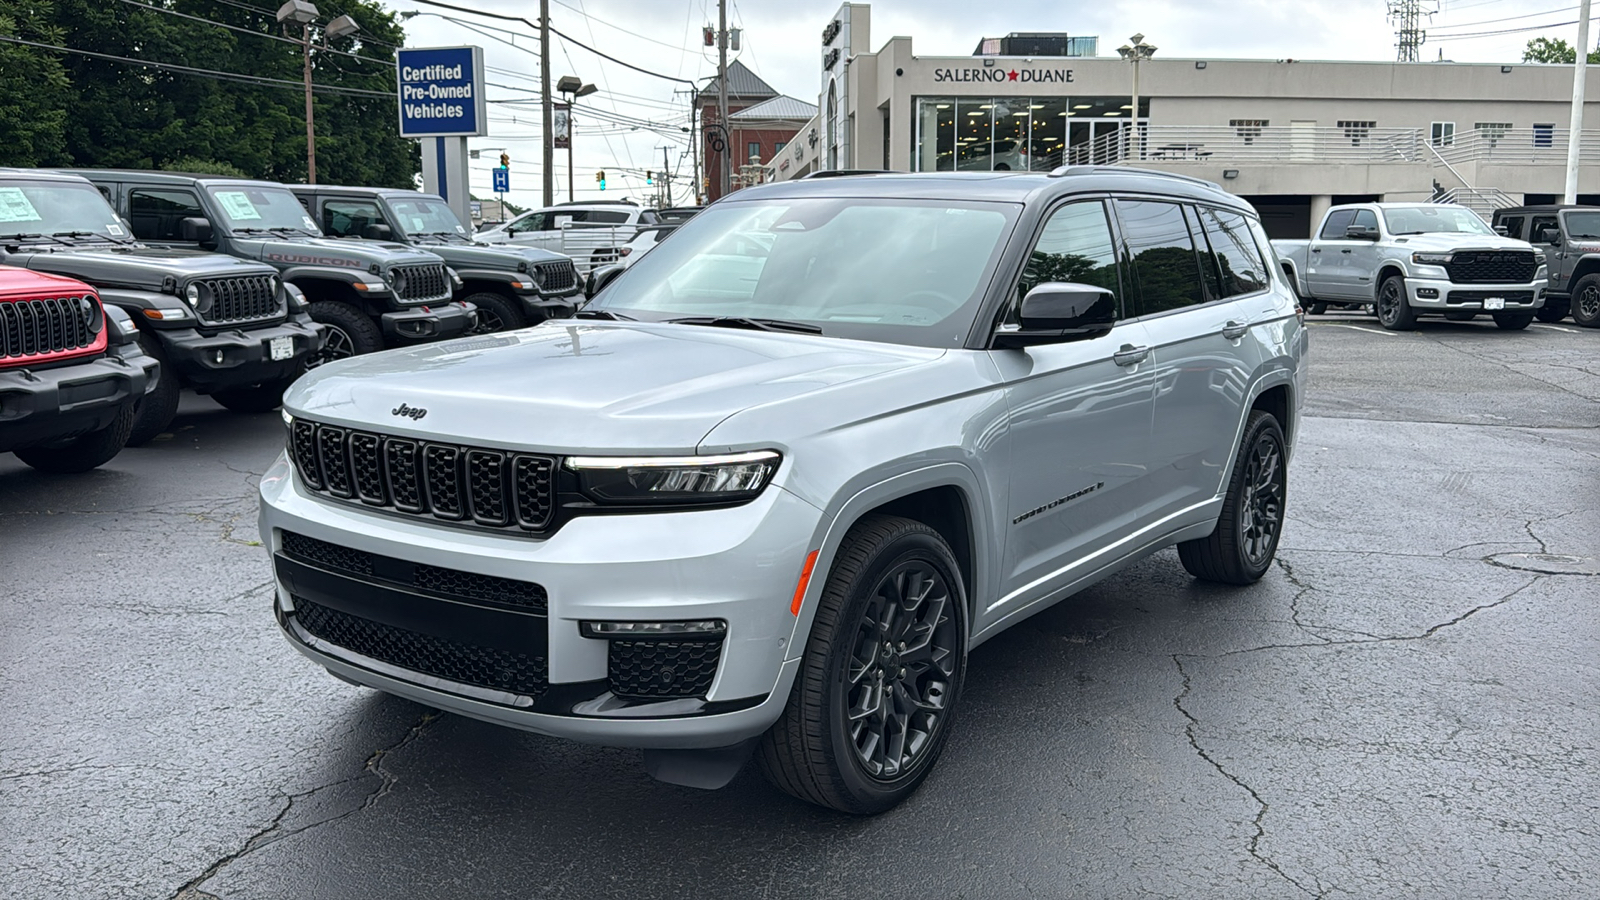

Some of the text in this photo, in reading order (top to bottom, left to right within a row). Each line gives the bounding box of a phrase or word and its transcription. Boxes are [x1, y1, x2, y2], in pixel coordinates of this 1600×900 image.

[402, 64, 462, 81] Certified
[934, 68, 1074, 83] SALERNO DUANE
[403, 83, 472, 100] Pre-Owned
[404, 103, 464, 119] Vehicles
[496, 173, 506, 186] H
[268, 253, 361, 267] RUBICON
[391, 402, 428, 421] Jeep
